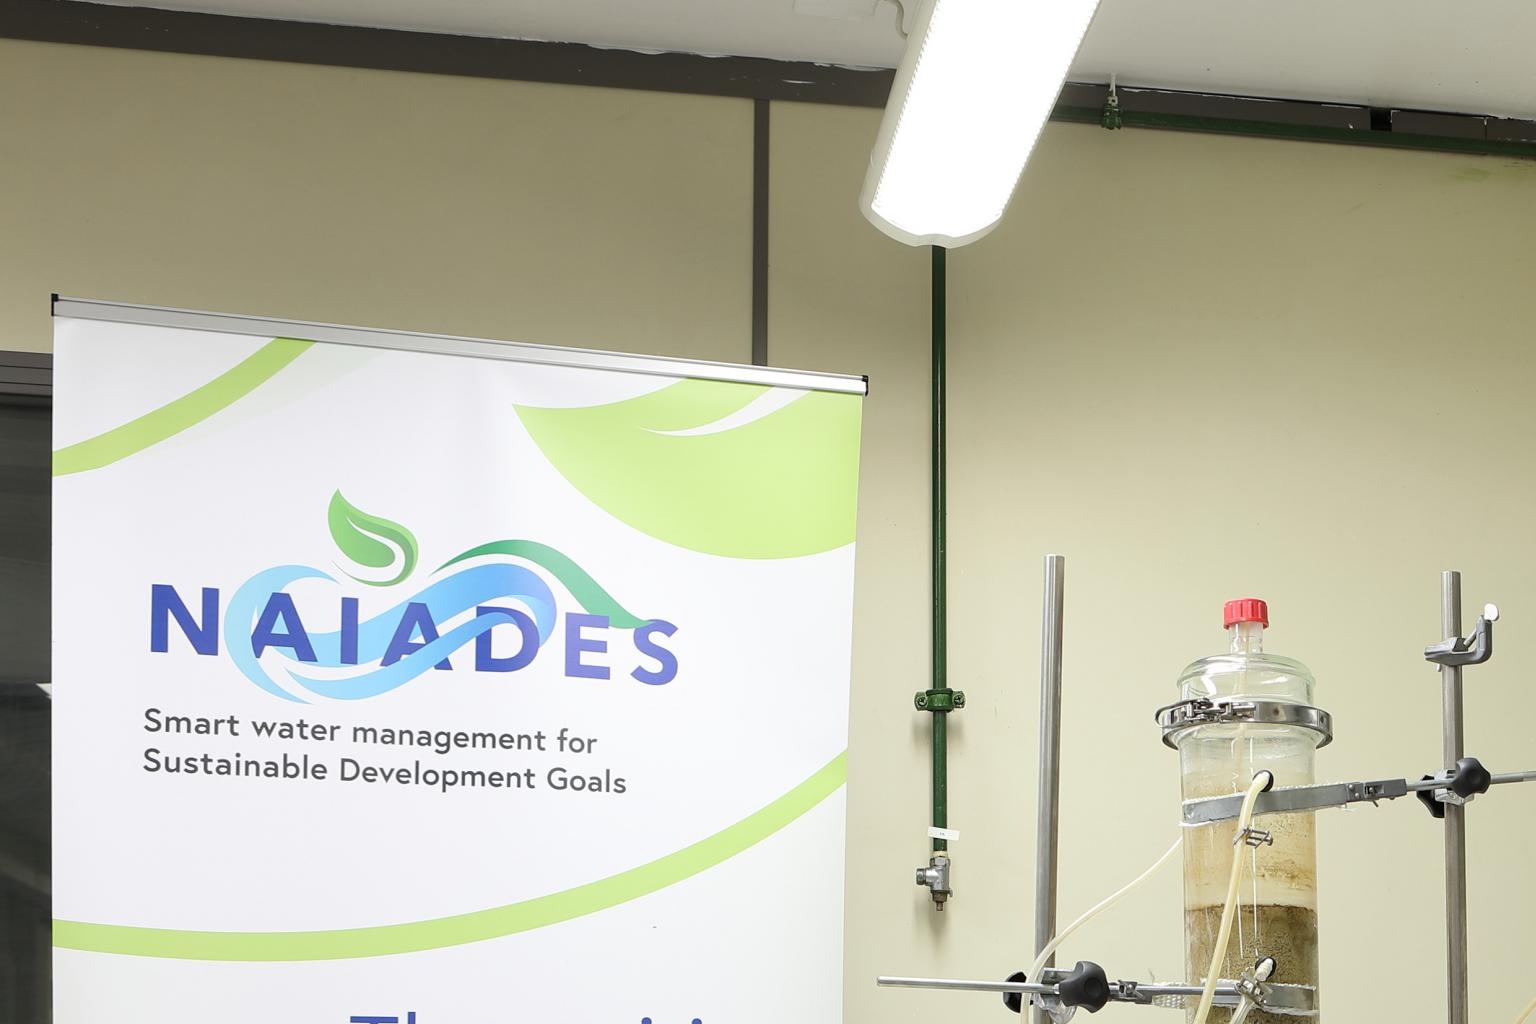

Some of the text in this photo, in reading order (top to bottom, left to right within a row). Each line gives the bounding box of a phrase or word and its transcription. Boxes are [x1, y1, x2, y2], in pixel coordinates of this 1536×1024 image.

[149, 583, 680, 686] NAIADES
[143, 707, 599, 756] Smart water management for
[143, 747, 627, 794] Sustainable Development Goals
